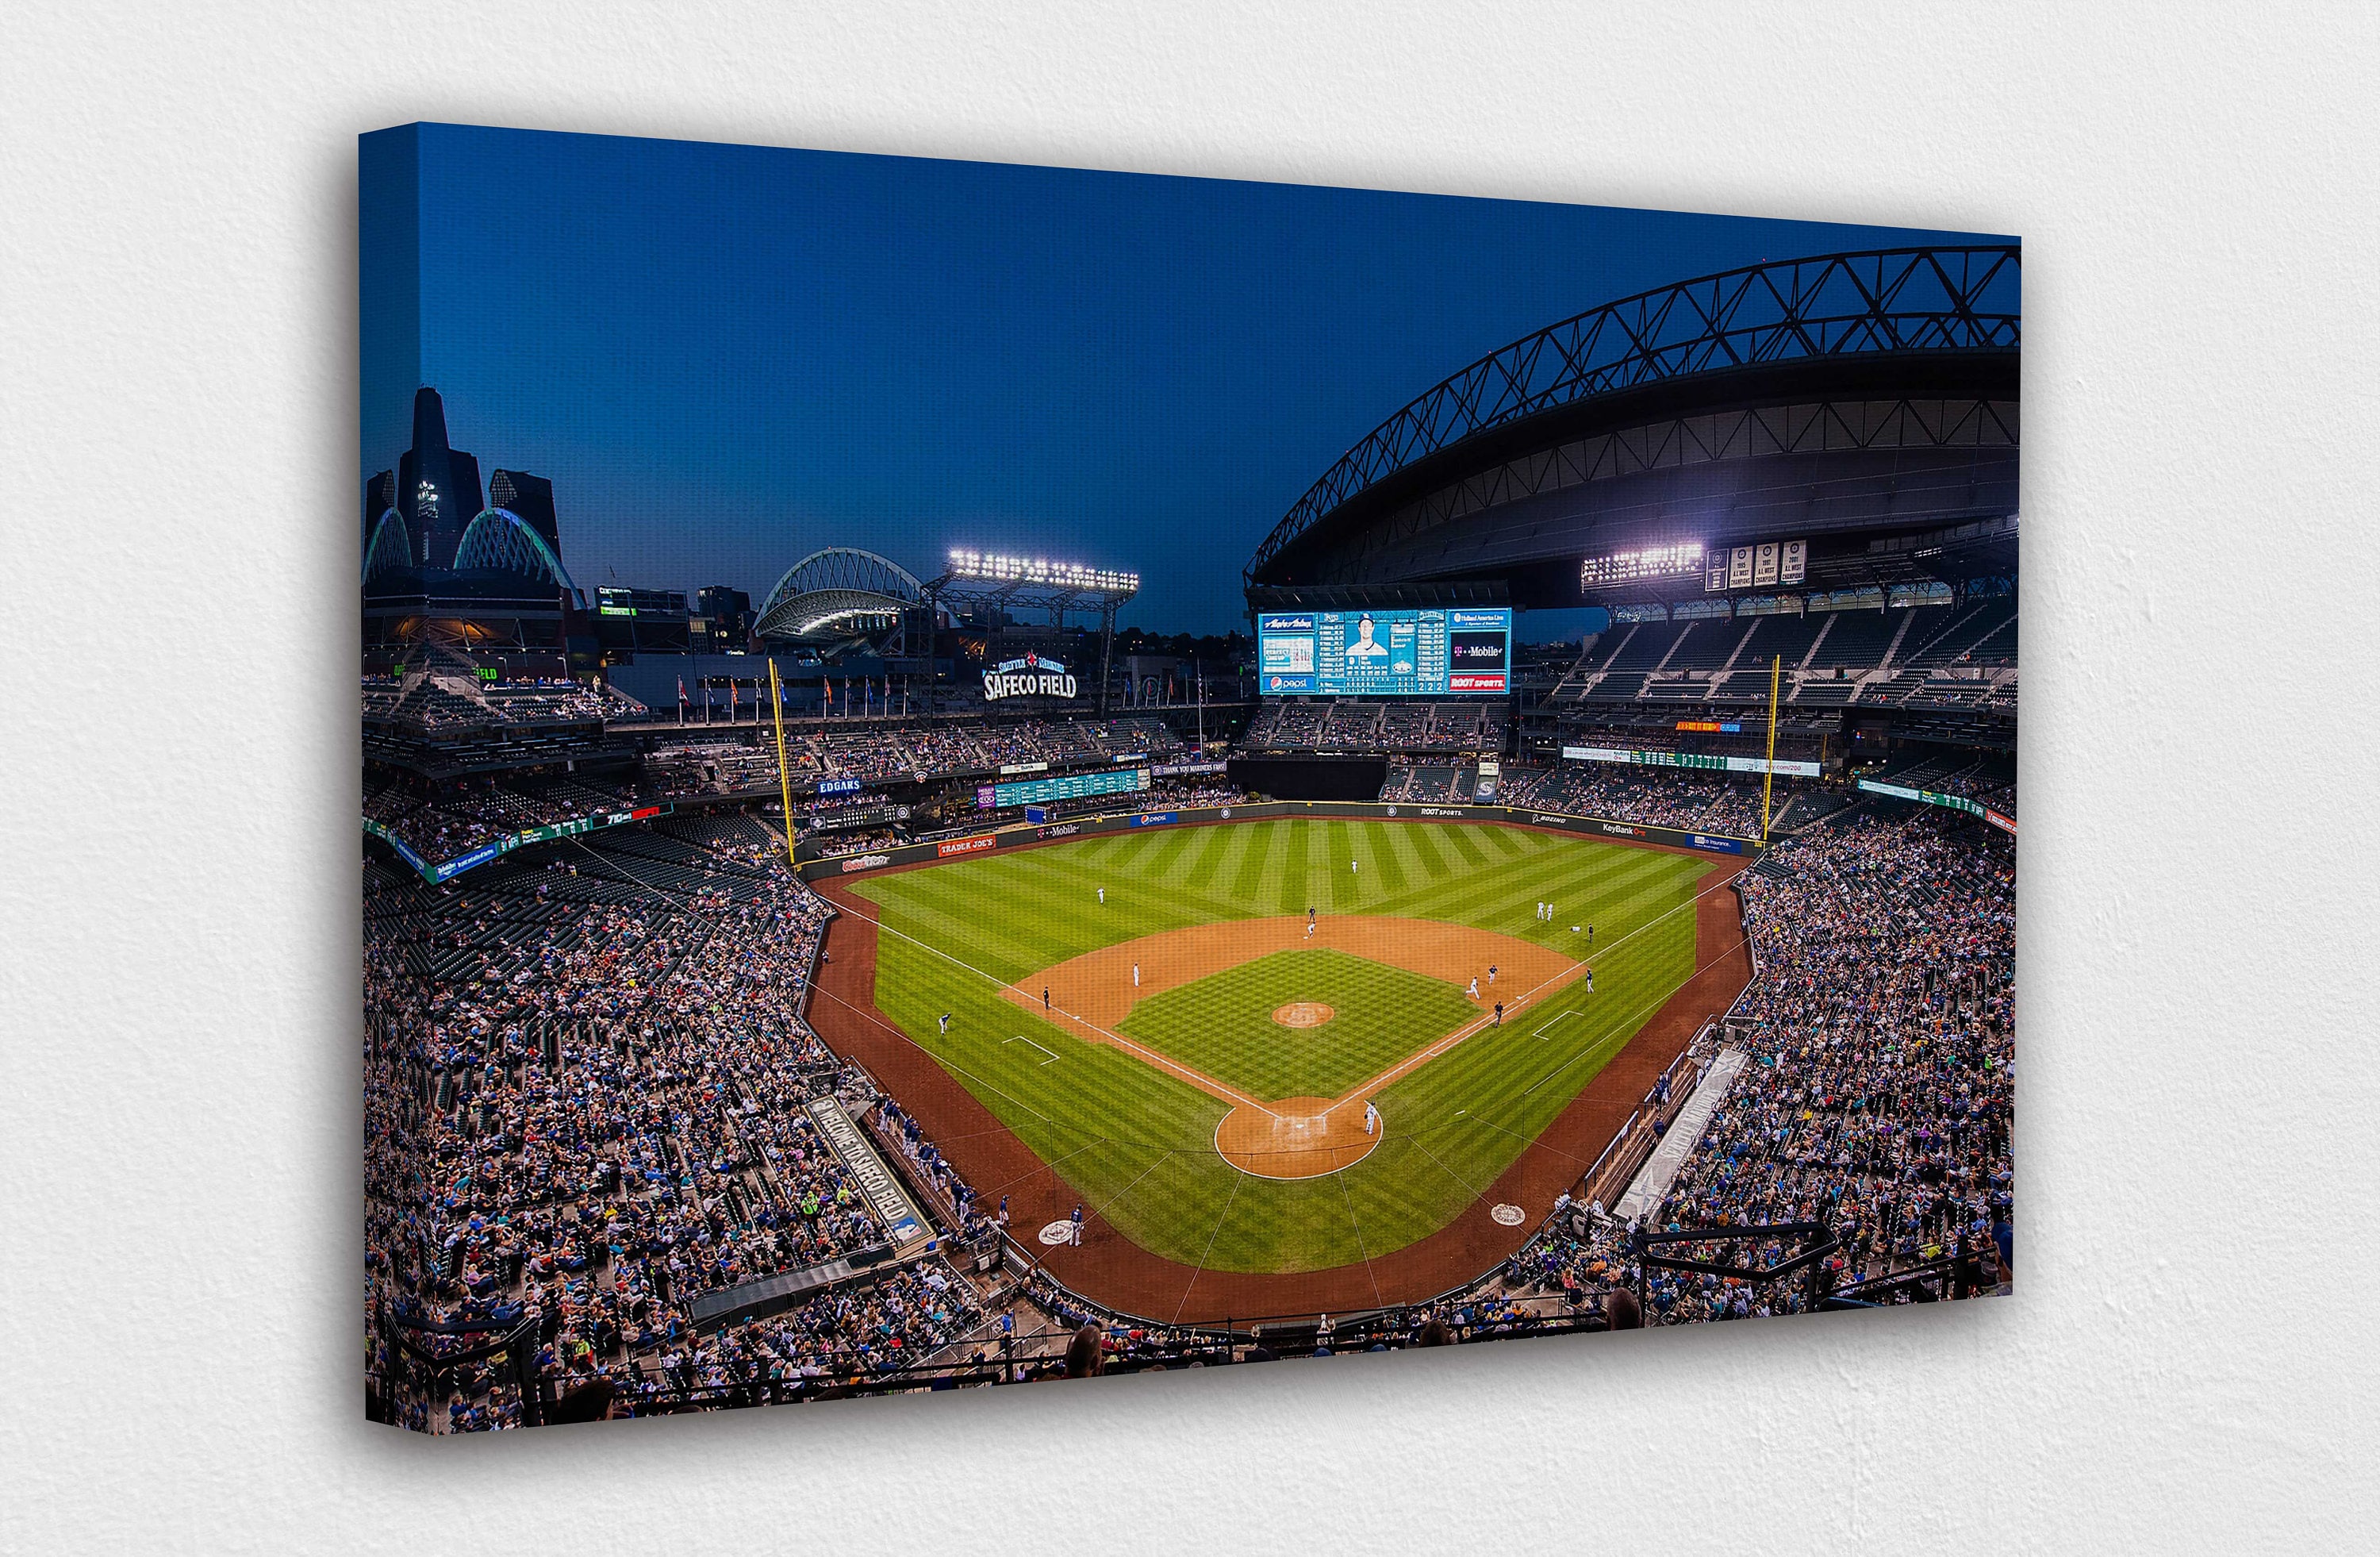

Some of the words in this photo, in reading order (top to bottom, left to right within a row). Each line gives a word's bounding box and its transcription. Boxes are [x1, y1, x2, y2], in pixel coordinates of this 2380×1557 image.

[985, 675, 1037, 701] SAFECO
[1038, 675, 1077, 698] FIELD
[820, 780, 860, 793] EDGARS
[1150, 814, 1166, 823] pepsi
[1603, 823, 1633, 836] KeyBank
[942, 842, 970, 854] TRADER
[973, 839, 993, 848] JOE'S
[818, 1108, 858, 1148] WELCOME
[843, 1143, 868, 1162] TO
[850, 1156, 889, 1191] SAFECO
[872, 1188, 908, 1220] FIELD
